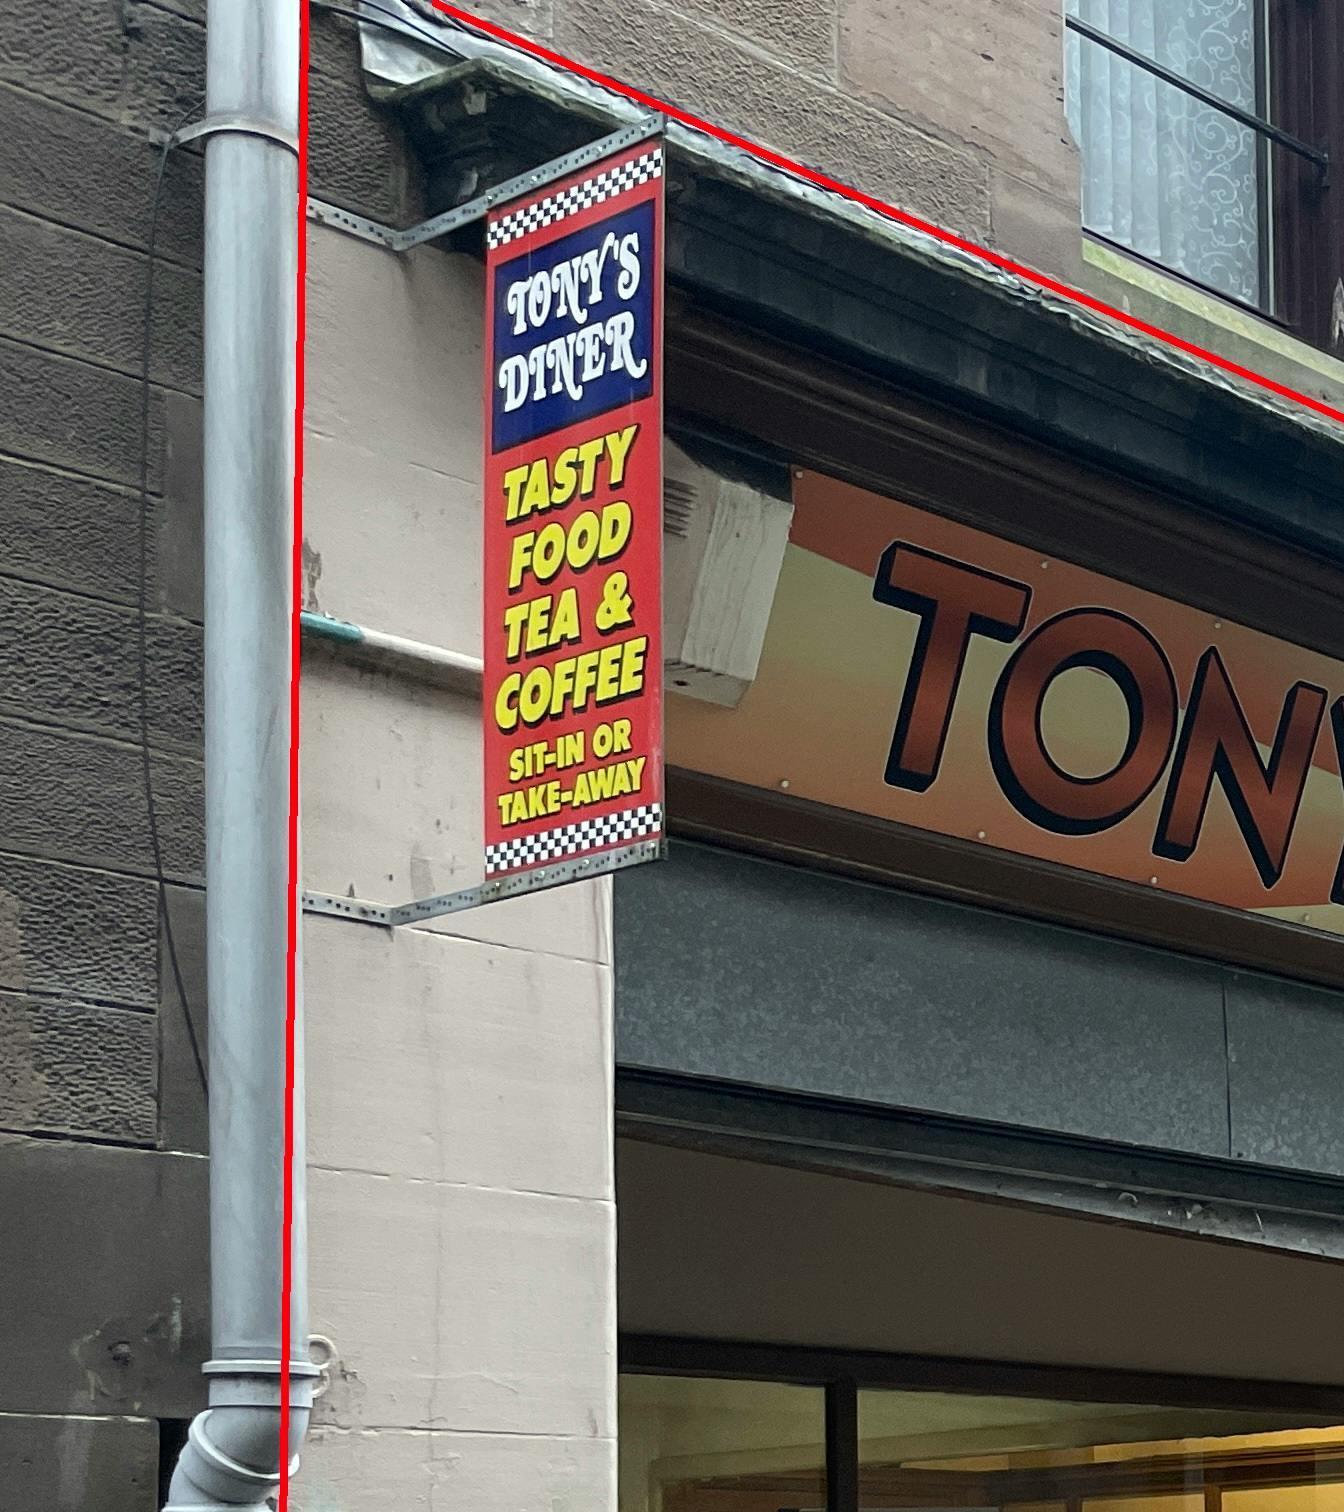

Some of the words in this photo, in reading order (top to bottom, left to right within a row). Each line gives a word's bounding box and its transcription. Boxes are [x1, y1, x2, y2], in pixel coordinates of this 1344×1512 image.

[507, 231, 641, 336] TONY'S
[499, 311, 647, 412] DINER
[502, 424, 640, 522] TASTY
[507, 501, 633, 591] FOOD
[504, 587, 579, 661] TEA
[595, 572, 633, 634] &
[494, 636, 648, 731] COFFEE
[497, 756, 647, 827] TAKE-AWAY
[508, 729, 585, 781] SIT-IN
[592, 717, 633, 756] OR
